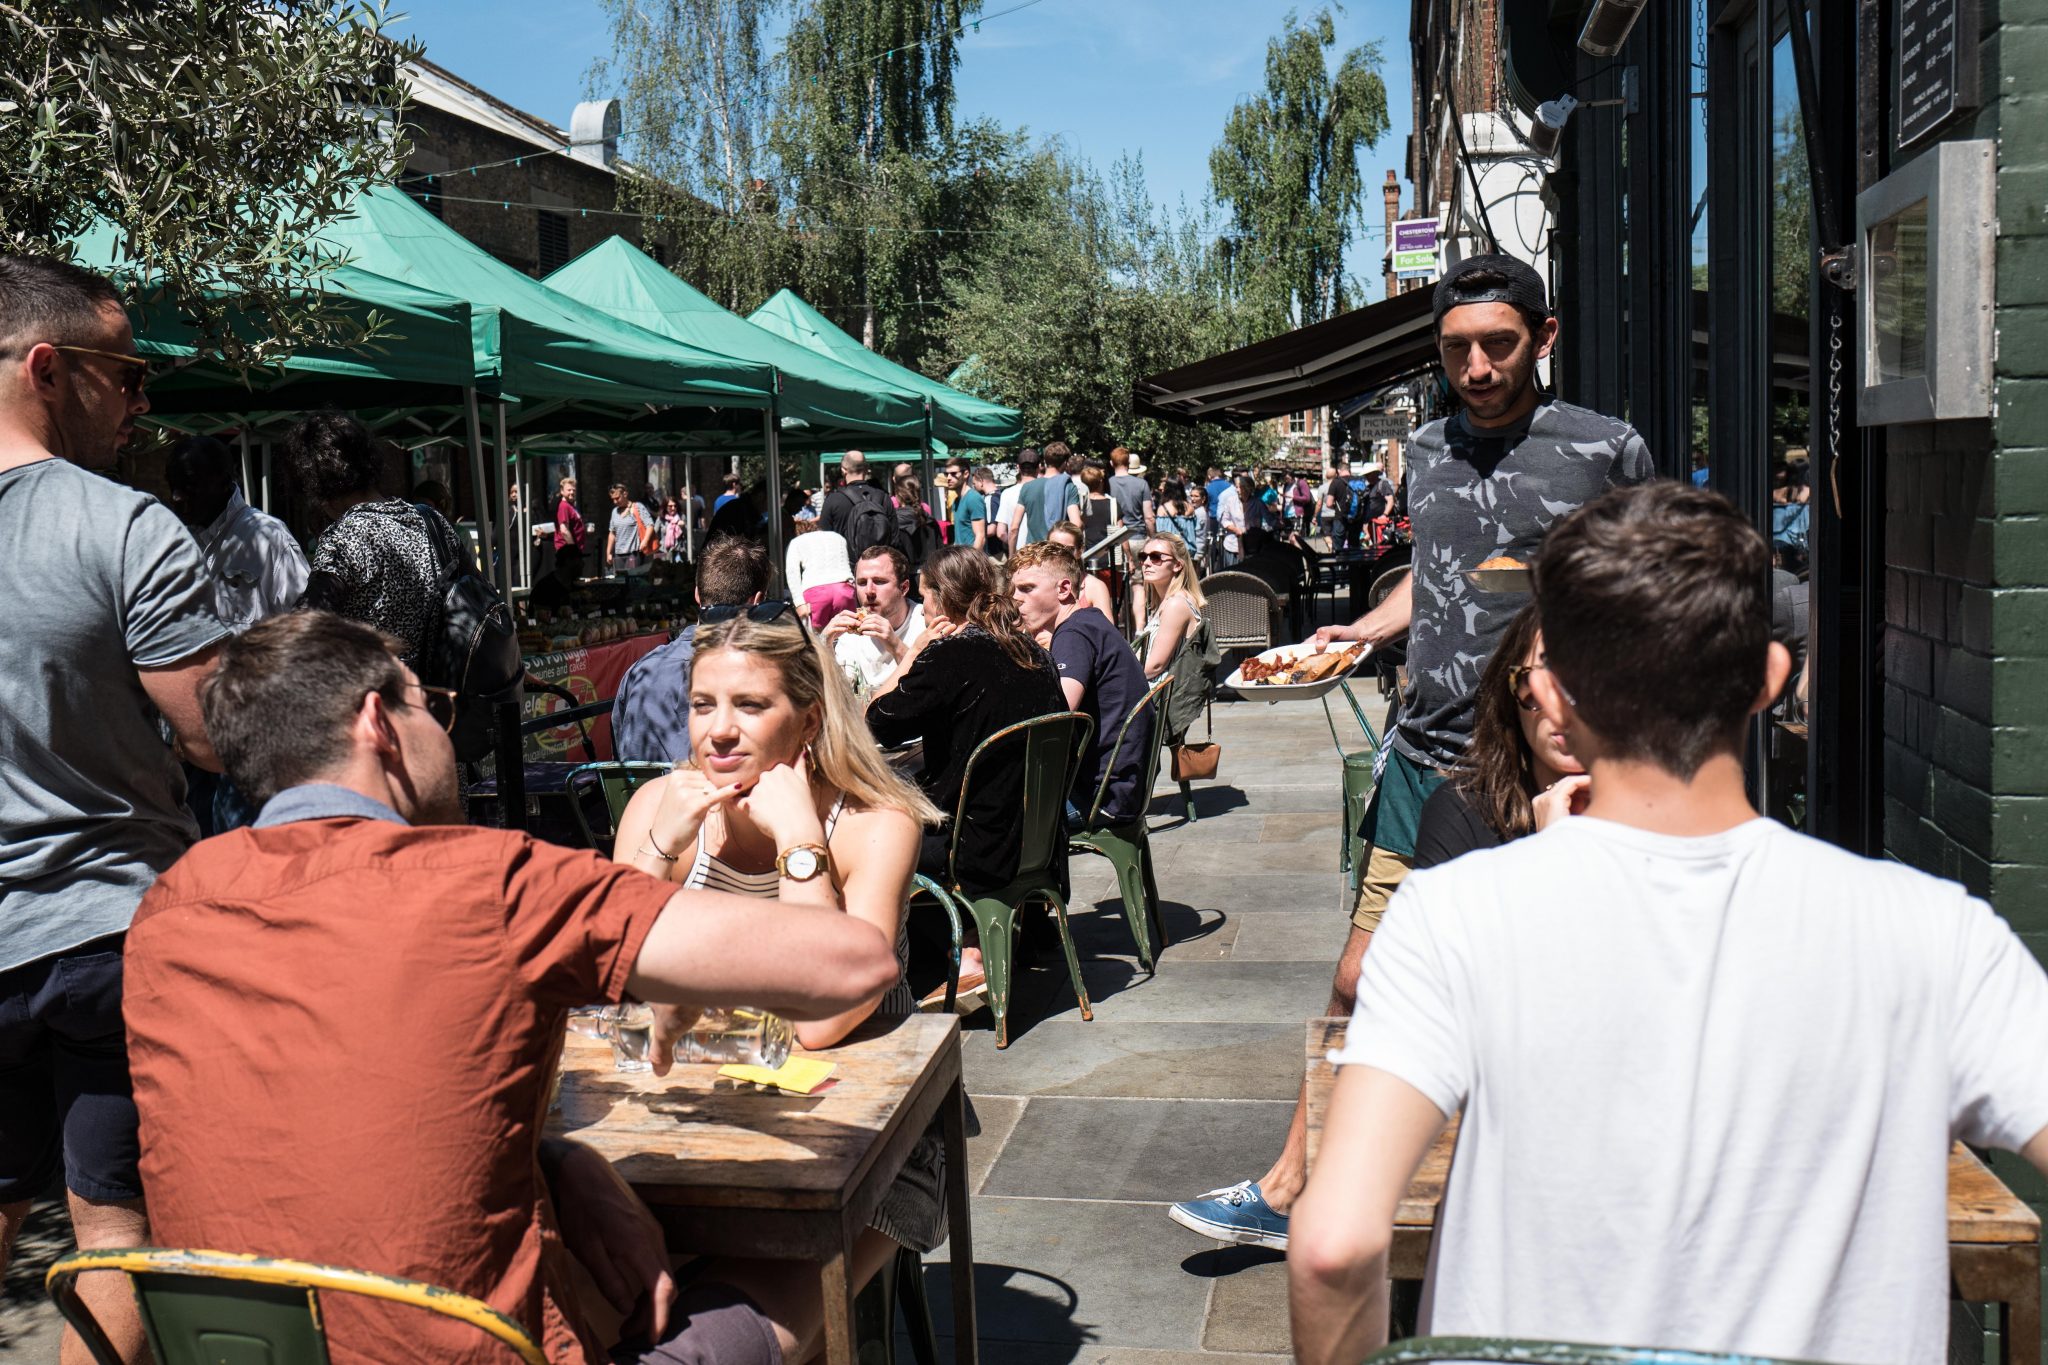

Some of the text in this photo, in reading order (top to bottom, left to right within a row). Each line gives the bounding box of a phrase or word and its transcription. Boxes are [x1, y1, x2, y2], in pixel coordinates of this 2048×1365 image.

[1400, 256, 1413, 265] For
[1364, 418, 1405, 428] PICTURE
[1362, 428, 1407, 438] FRAMING
[569, 659, 587, 673] cakes
